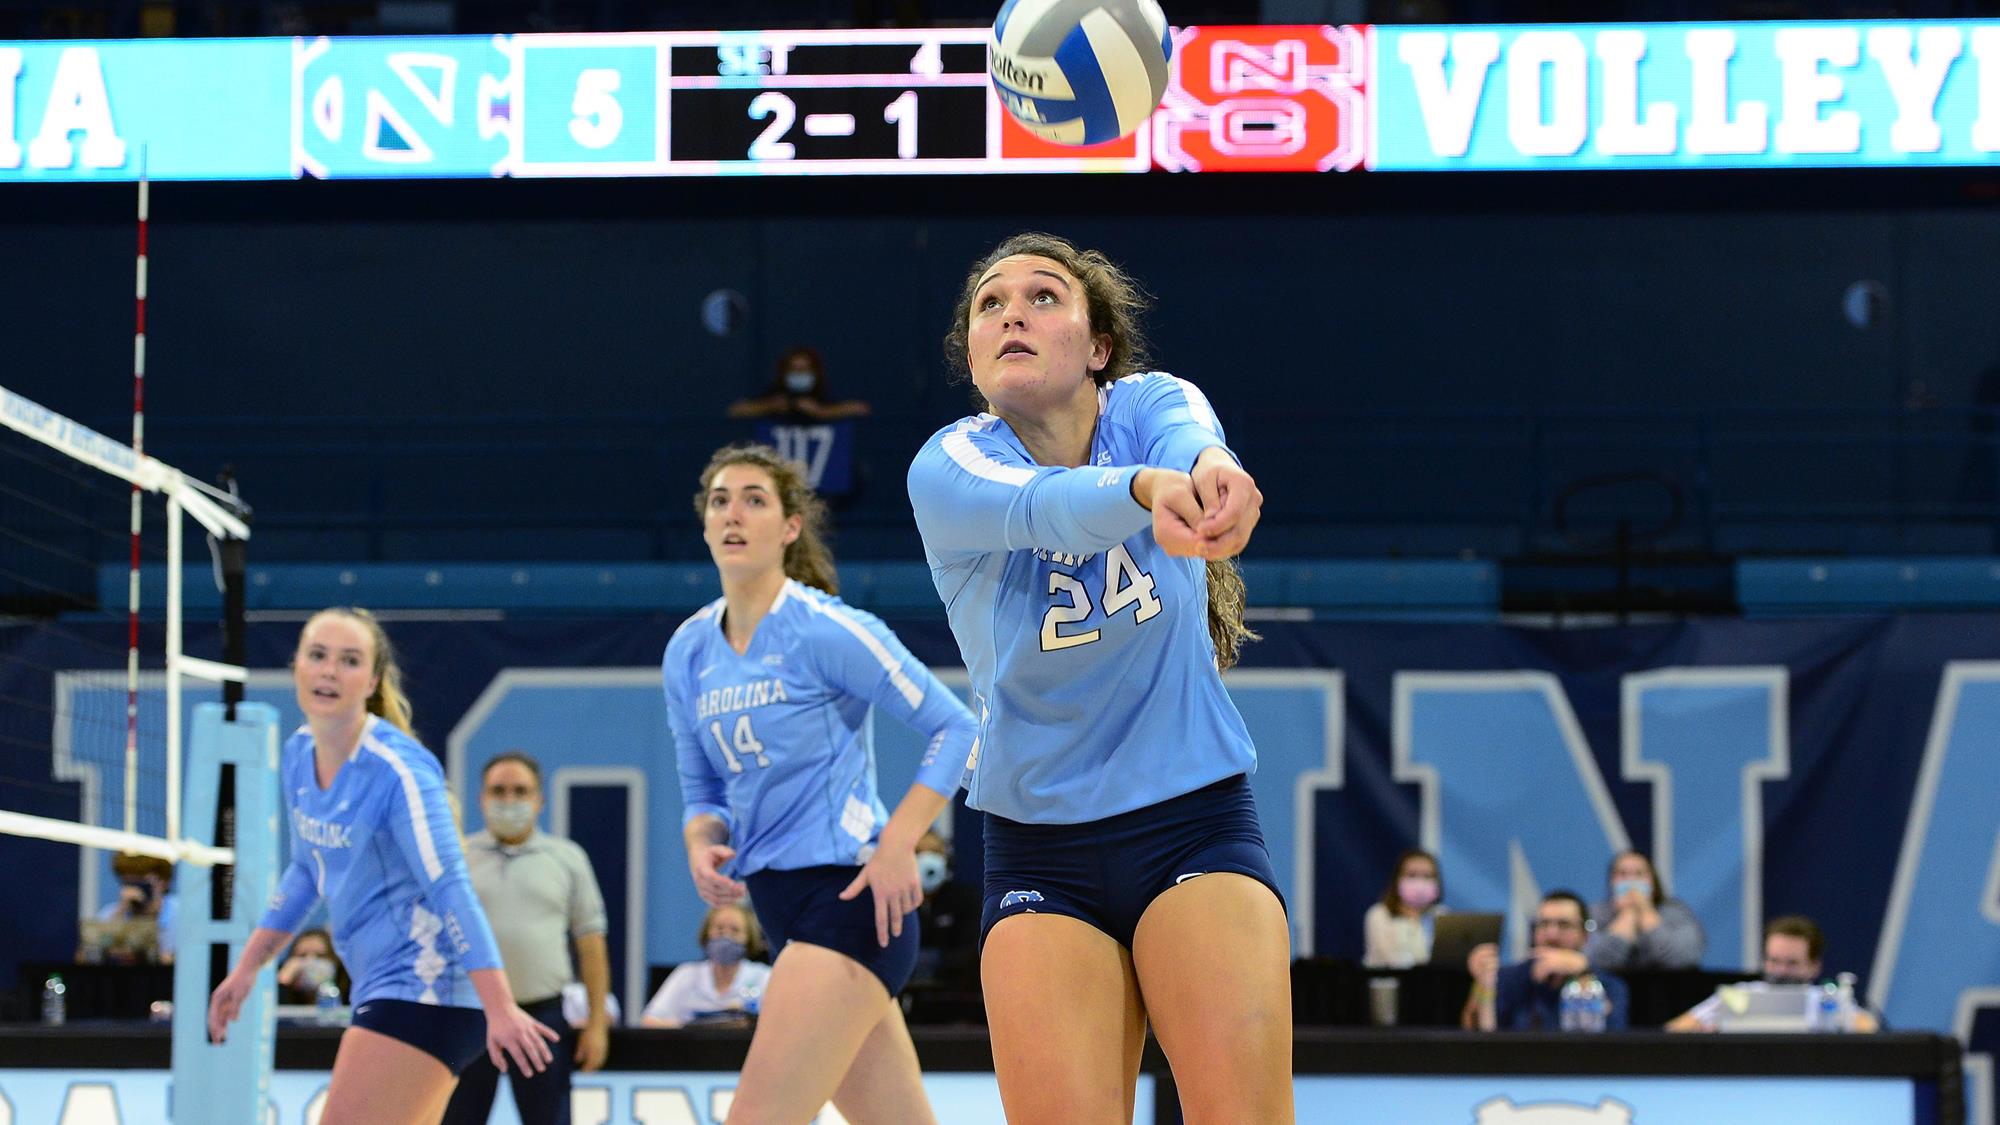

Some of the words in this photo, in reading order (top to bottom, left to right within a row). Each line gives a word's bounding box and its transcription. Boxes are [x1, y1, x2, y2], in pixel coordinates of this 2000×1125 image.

[716, 40, 797, 76] SET
[909, 36, 945, 82] 4
[568, 68, 624, 149] 5
[1039, 541, 1163, 653] 24
[696, 678, 787, 720] AROLINA
[709, 713, 771, 774] 14
